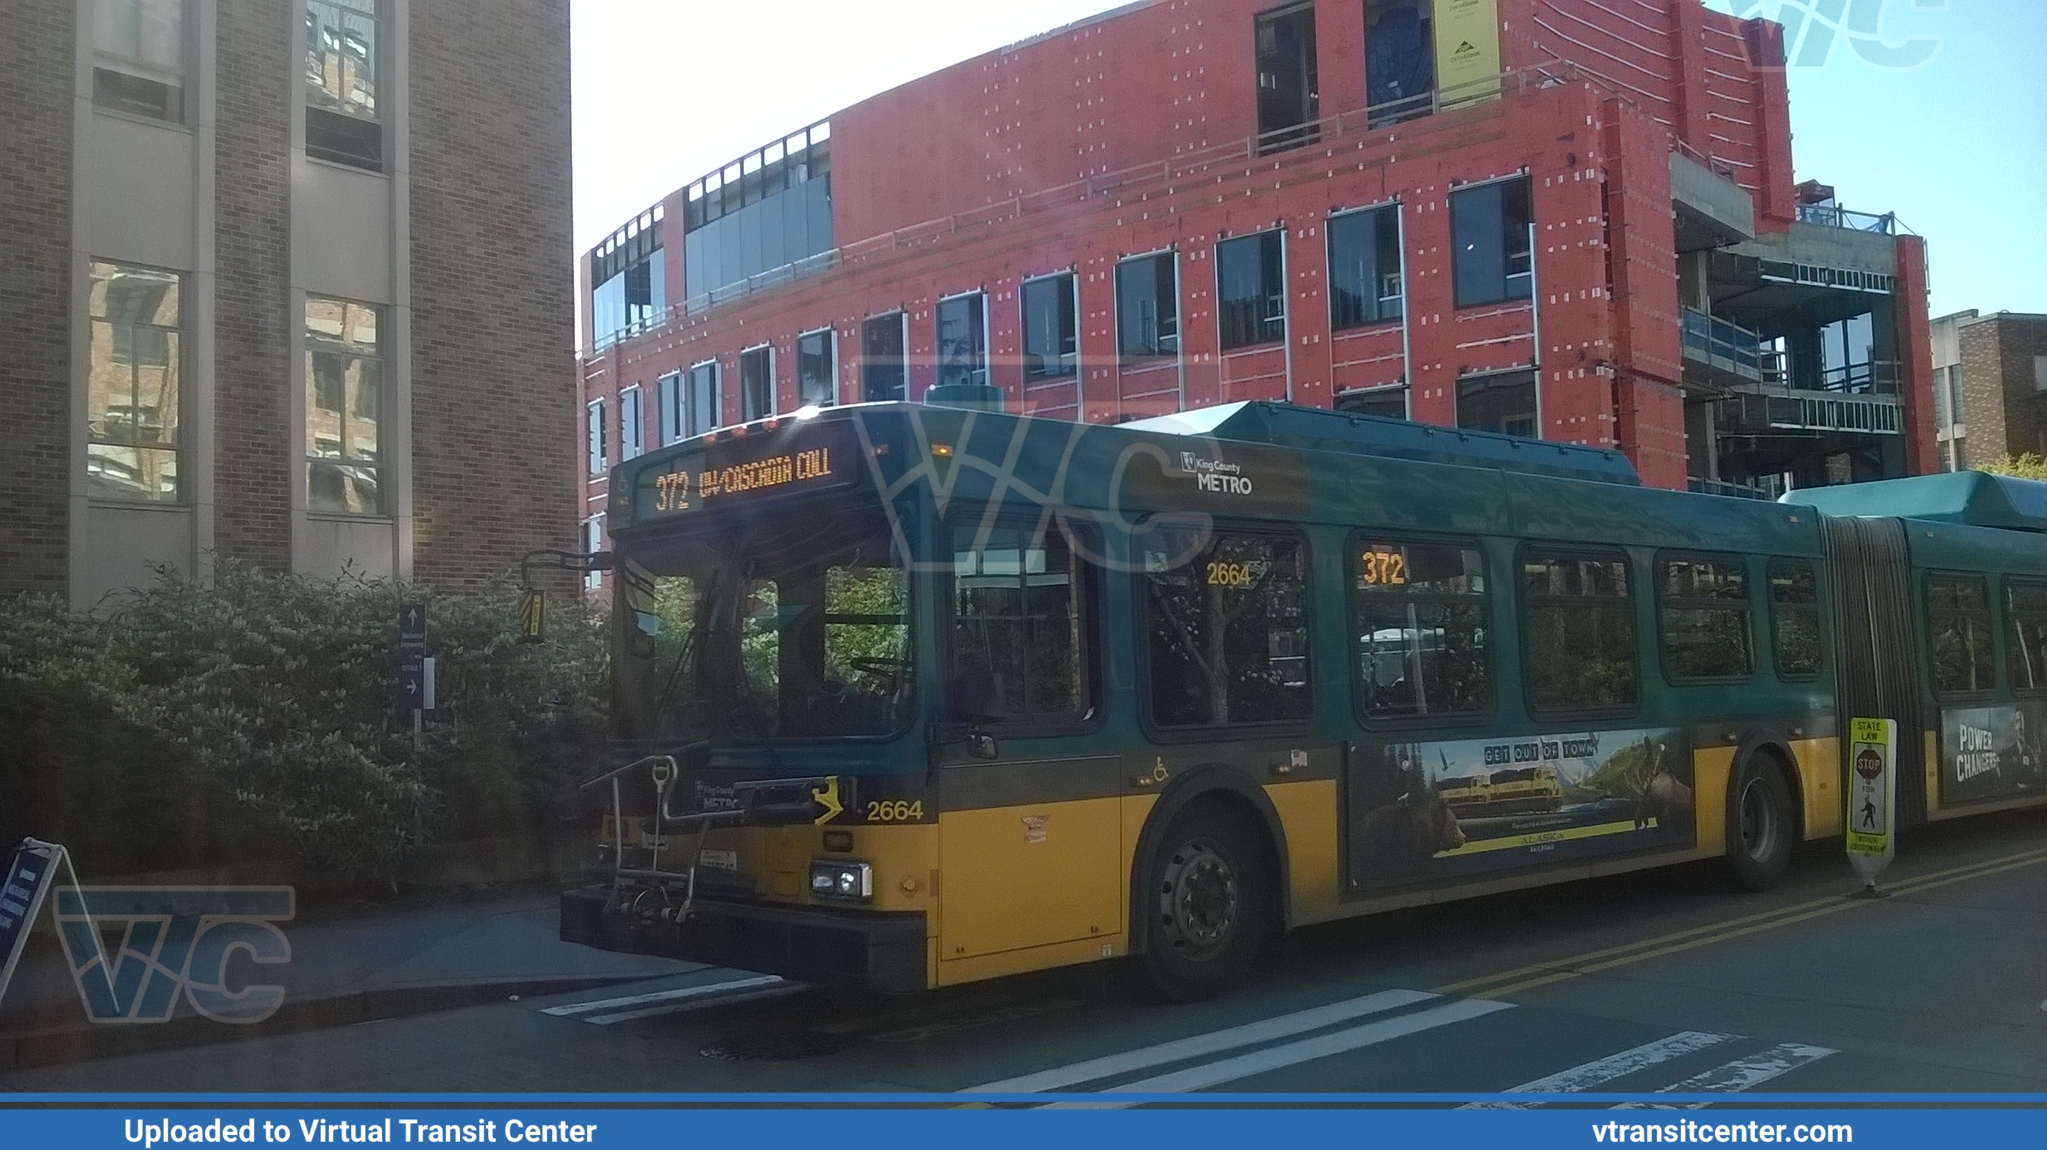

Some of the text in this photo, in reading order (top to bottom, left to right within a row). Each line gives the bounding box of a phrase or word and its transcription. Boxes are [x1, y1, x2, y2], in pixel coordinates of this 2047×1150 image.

[1196, 458, 1241, 475] King County
[656, 471, 689, 511] 372
[796, 447, 832, 479] COLL
[1198, 473, 1252, 495] METRO
[1207, 562, 1251, 586] 2664
[1362, 552, 1405, 585] 372
[1857, 721, 1882, 731] STATE
[1861, 733, 1878, 741] LAW
[1959, 724, 1993, 752] POWER
[1485, 741, 1594, 763] GET OUT OF TOWN
[1858, 758, 1880, 770] STOP
[1956, 752, 1998, 782] CHANGERS
[867, 801, 923, 821] 2664
[1520, 832, 1564, 844] ALASKA
